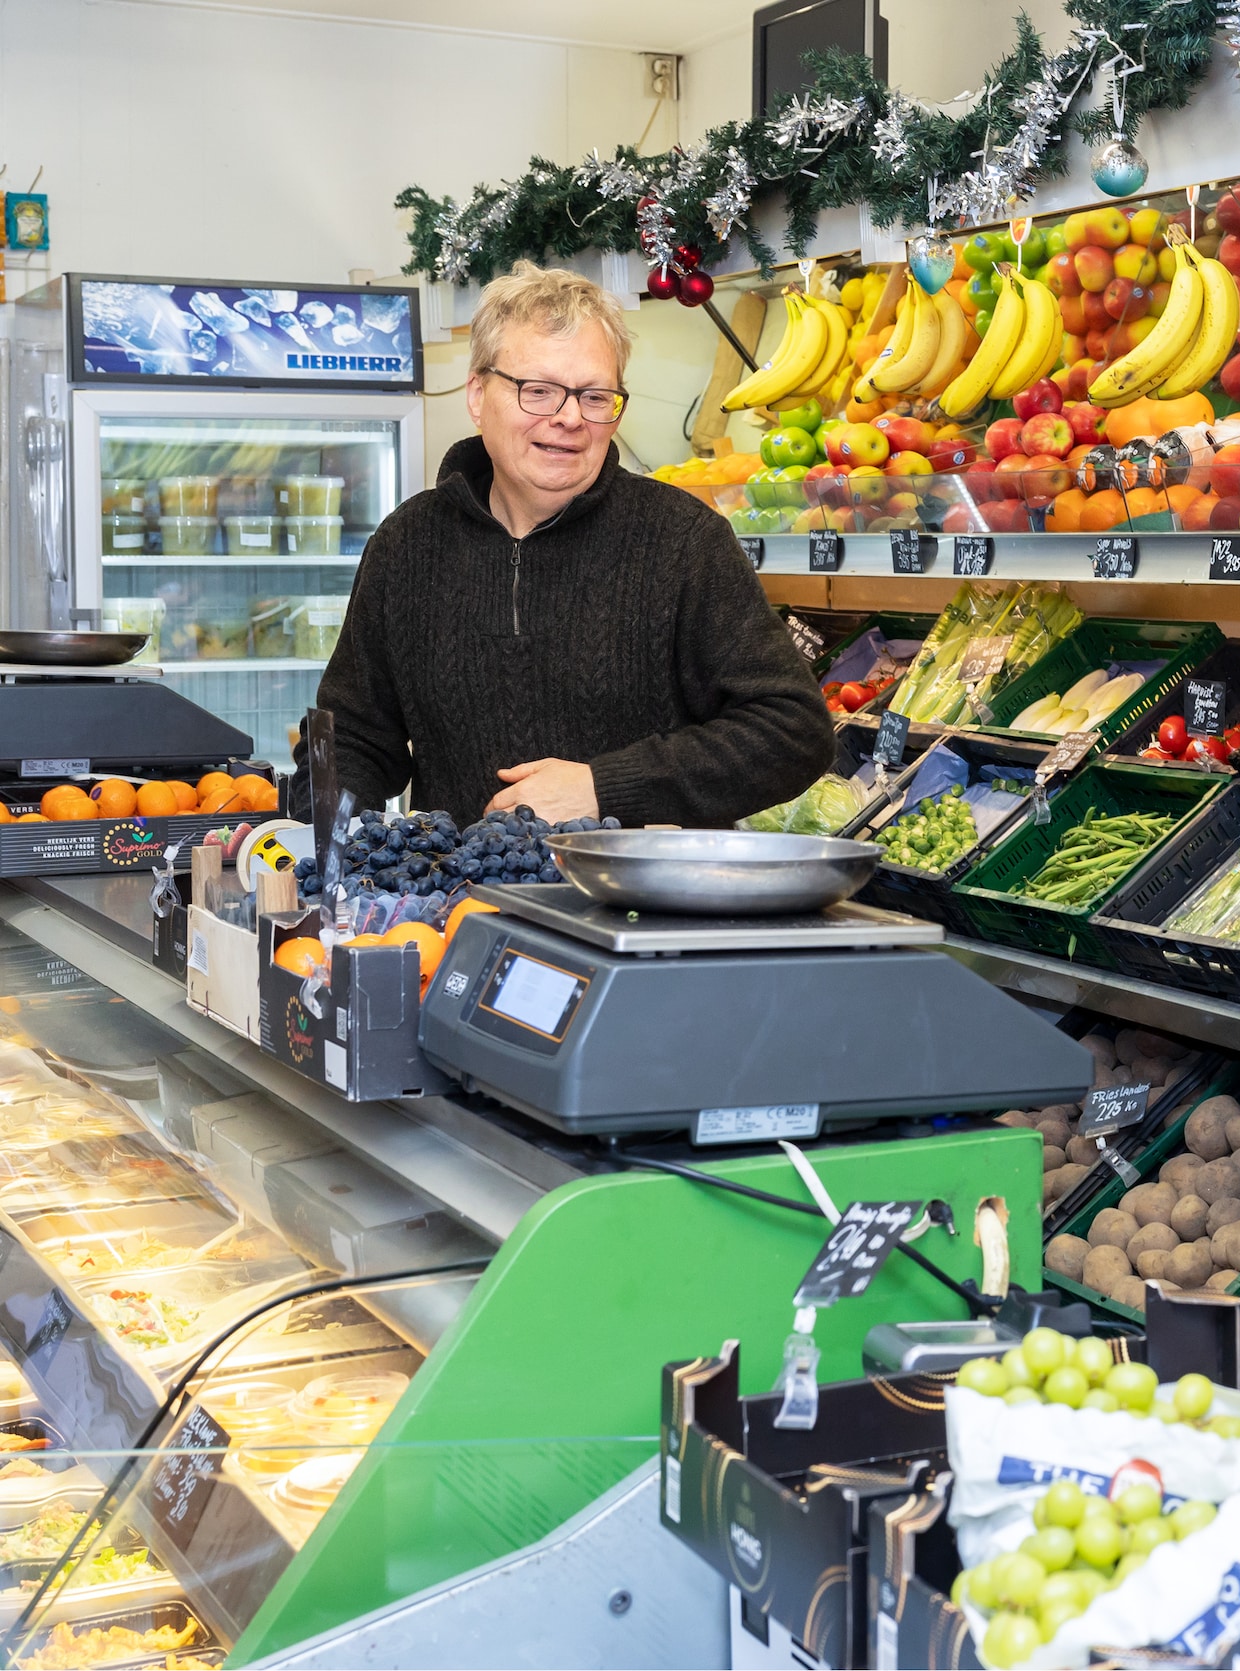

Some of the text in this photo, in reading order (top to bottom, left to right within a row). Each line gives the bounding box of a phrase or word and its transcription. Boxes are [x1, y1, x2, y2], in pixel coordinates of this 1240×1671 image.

[286, 353, 402, 373] LIEBHERR
[321, 422, 396, 433] LIEBHERR
[47, 837, 78, 845] HEERLIJK
[33, 844, 74, 853] DELICIOUSLY
[110, 837, 161, 858] Suprimo
[136, 849, 163, 858] GOLD
[785, 1107, 806, 1117] M20
